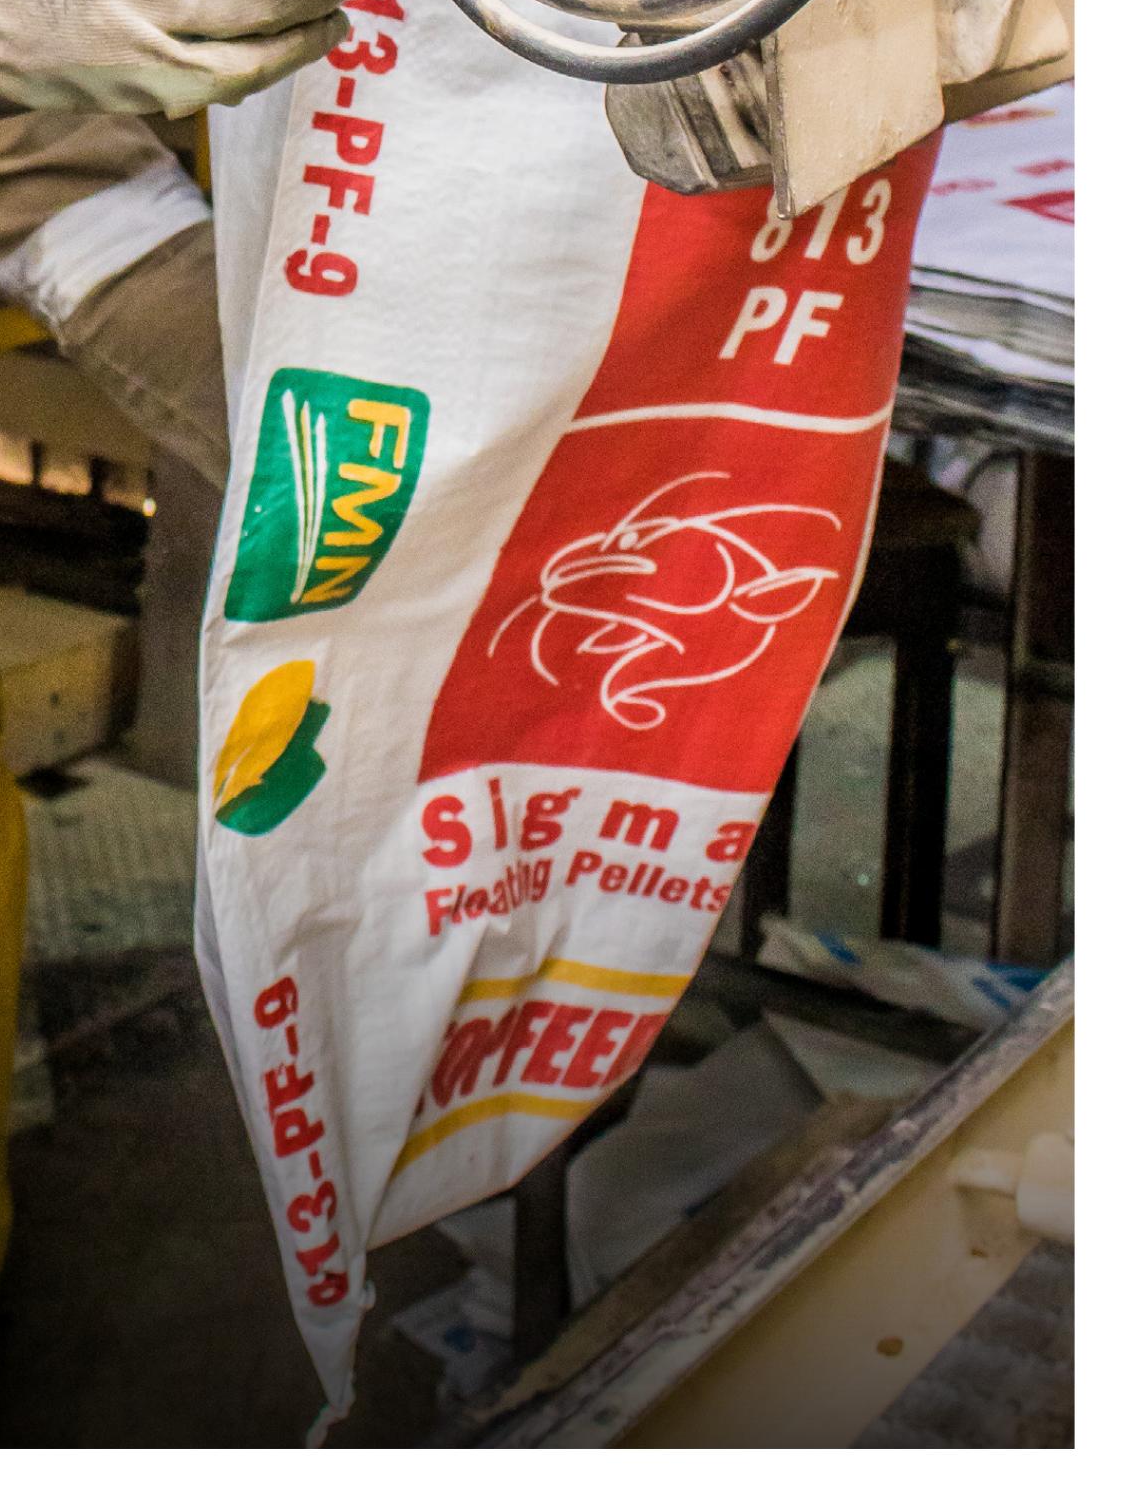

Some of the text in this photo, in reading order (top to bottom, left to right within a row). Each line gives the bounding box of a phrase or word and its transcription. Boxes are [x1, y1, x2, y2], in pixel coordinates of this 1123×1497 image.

[750, 178, 892, 265] 813
[717, 285, 845, 366] PF
[301, 398, 412, 604] FMN
[565, 850, 732, 913] Pellets
[416, 1000, 671, 1118] OPFEE
